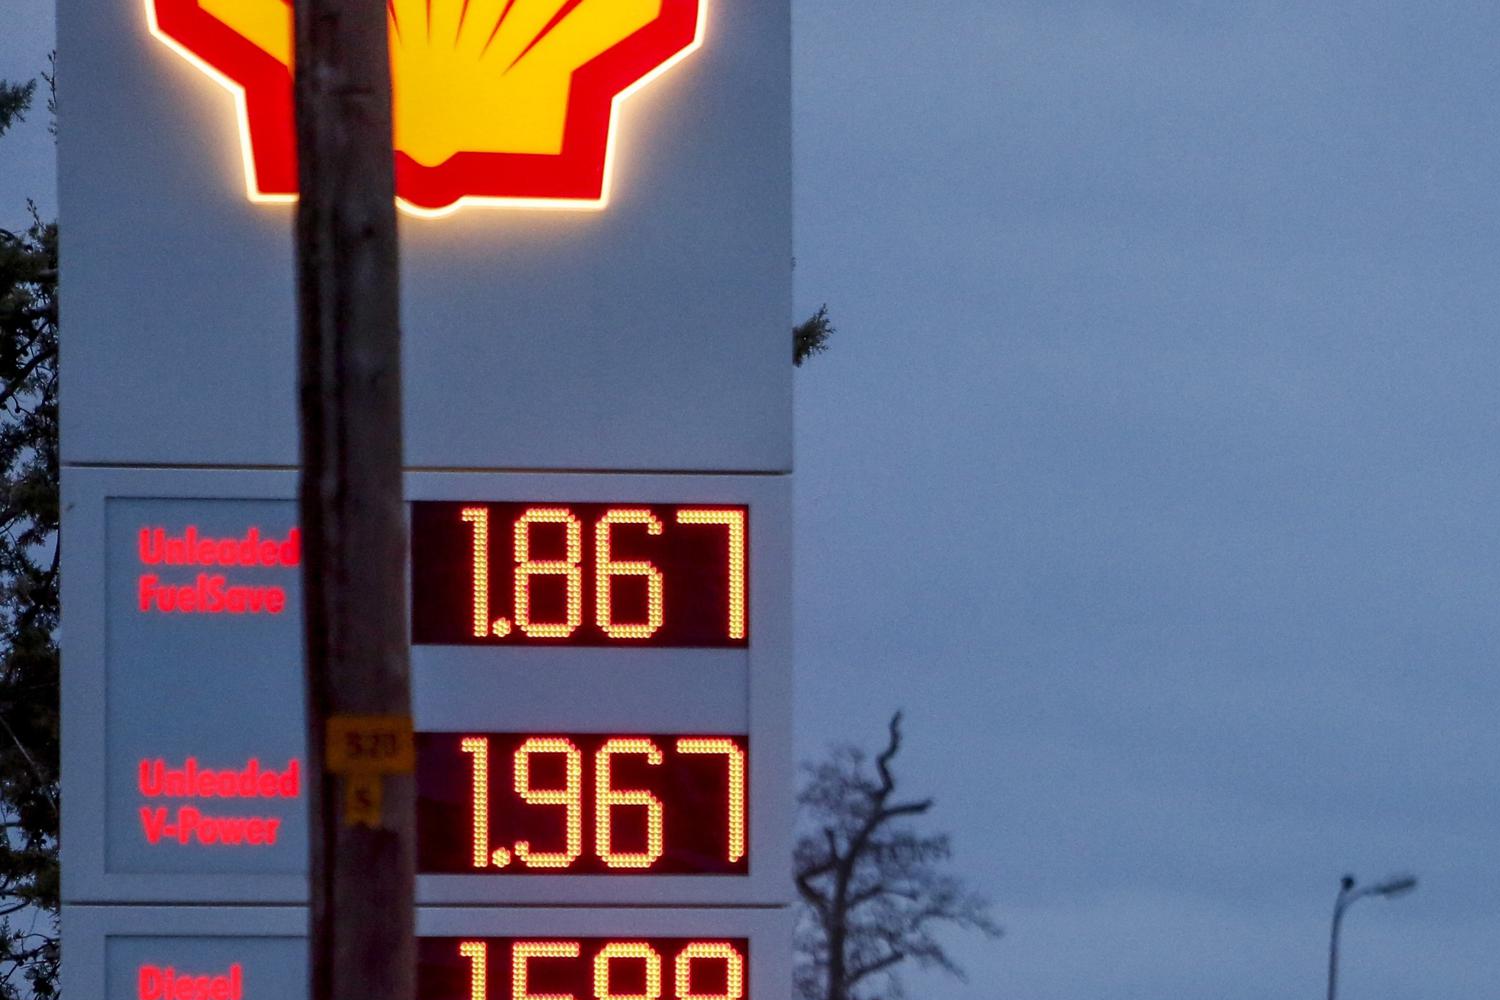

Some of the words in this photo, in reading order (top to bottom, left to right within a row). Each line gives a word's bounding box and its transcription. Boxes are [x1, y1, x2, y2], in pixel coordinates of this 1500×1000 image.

[139, 526, 300, 566] Unleaded
[461, 507, 746, 640] 1.867
[139, 574, 286, 614] FuelSave
[139, 758, 299, 798] Unleaded
[461, 738, 746, 868] 1.967
[139, 806, 280, 845] V-Power
